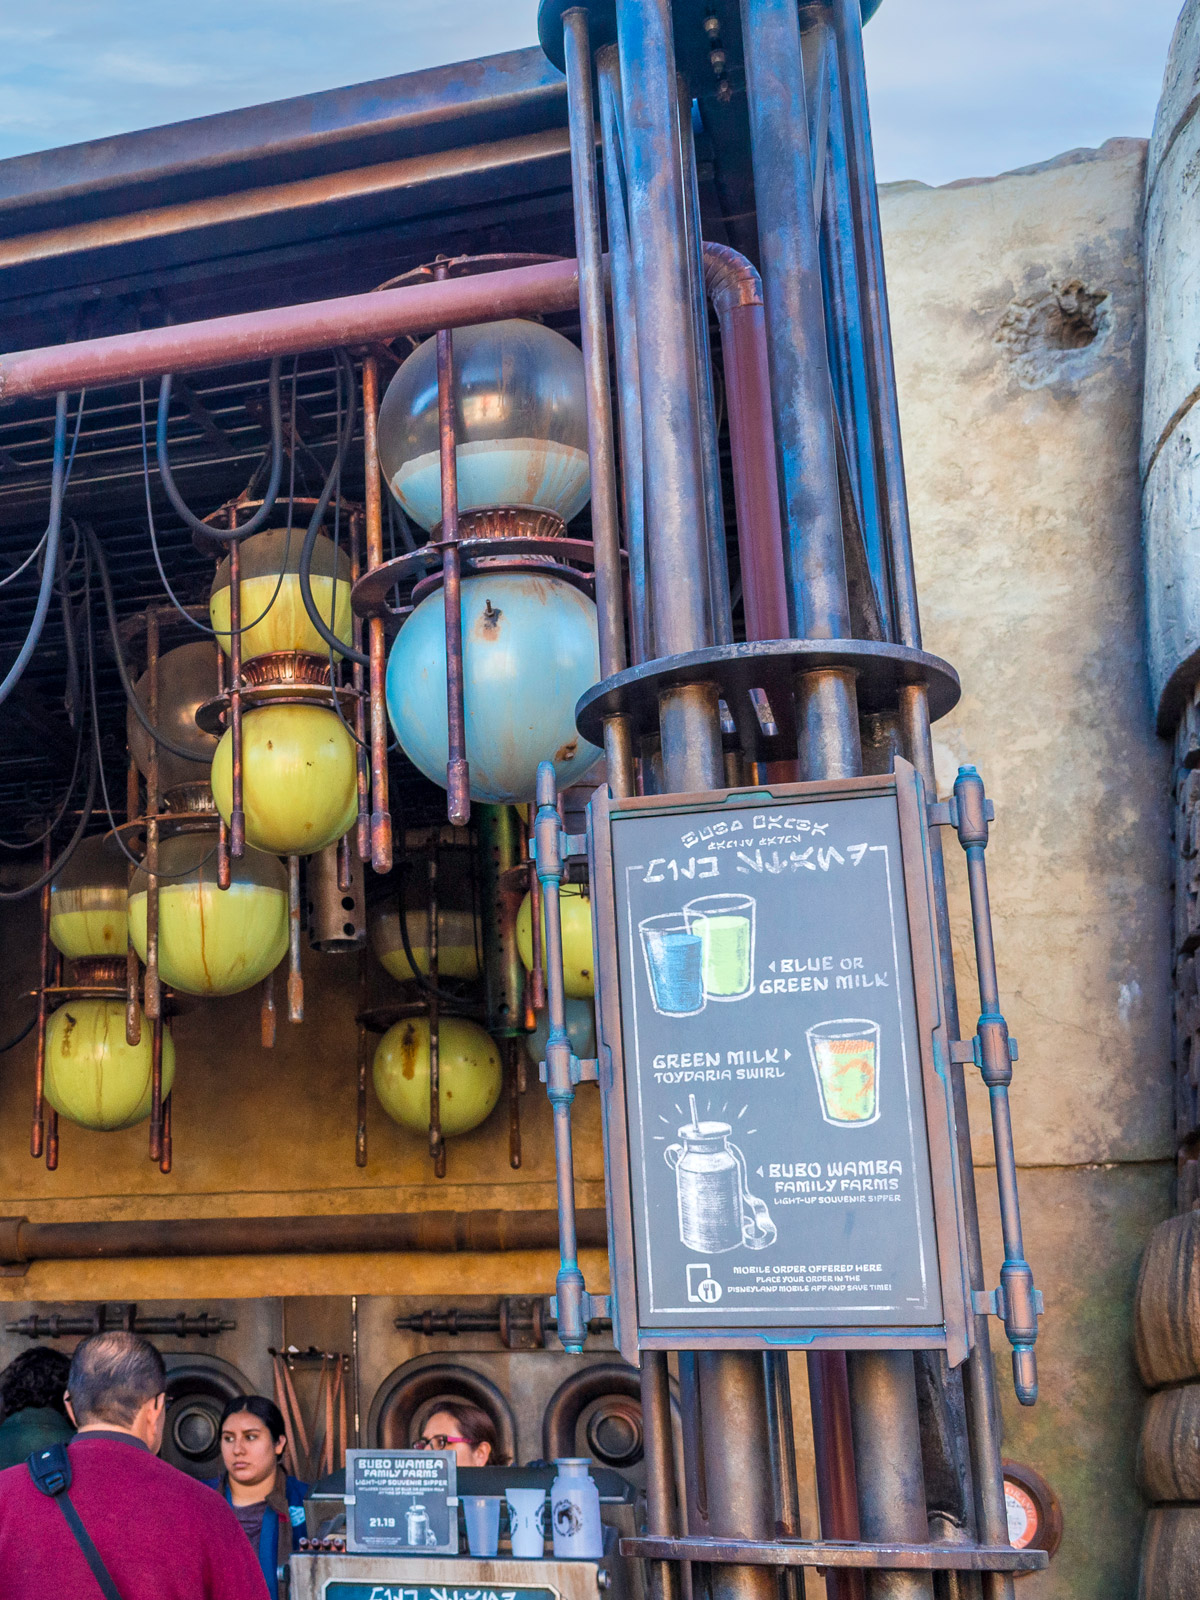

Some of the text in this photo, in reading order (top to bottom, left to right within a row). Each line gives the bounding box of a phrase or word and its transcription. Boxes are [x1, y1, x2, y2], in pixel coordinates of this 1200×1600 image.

[780, 956, 865, 973] BLUE OR
[759, 971, 890, 994] GREEN MILK
[652, 1048, 780, 1069] GREEN MILK
[653, 1067, 785, 1084] TOYDARIA SWIRL
[769, 1160, 903, 1178] BUBO WAMBA
[775, 1178, 899, 1193] FAMILY FARMS
[774, 1194, 901, 1205] LIGHT-UP SOUVENIR SIPPER
[733, 1263, 883, 1274] MOBILE ORDER OFFERED HERE
[755, 1276, 781, 1284] PLACE
[782, 1275, 805, 1283] YOUR
[805, 1275, 833, 1283] ORDER
[727, 1285, 778, 1293] DISNEYLAND
[828, 1284, 846, 1292] AND
[358, 1459, 444, 1470] BUBO WAMBA
[364, 1469, 438, 1478] FAMILY FARMS
[369, 1517, 396, 1528] 21.19
